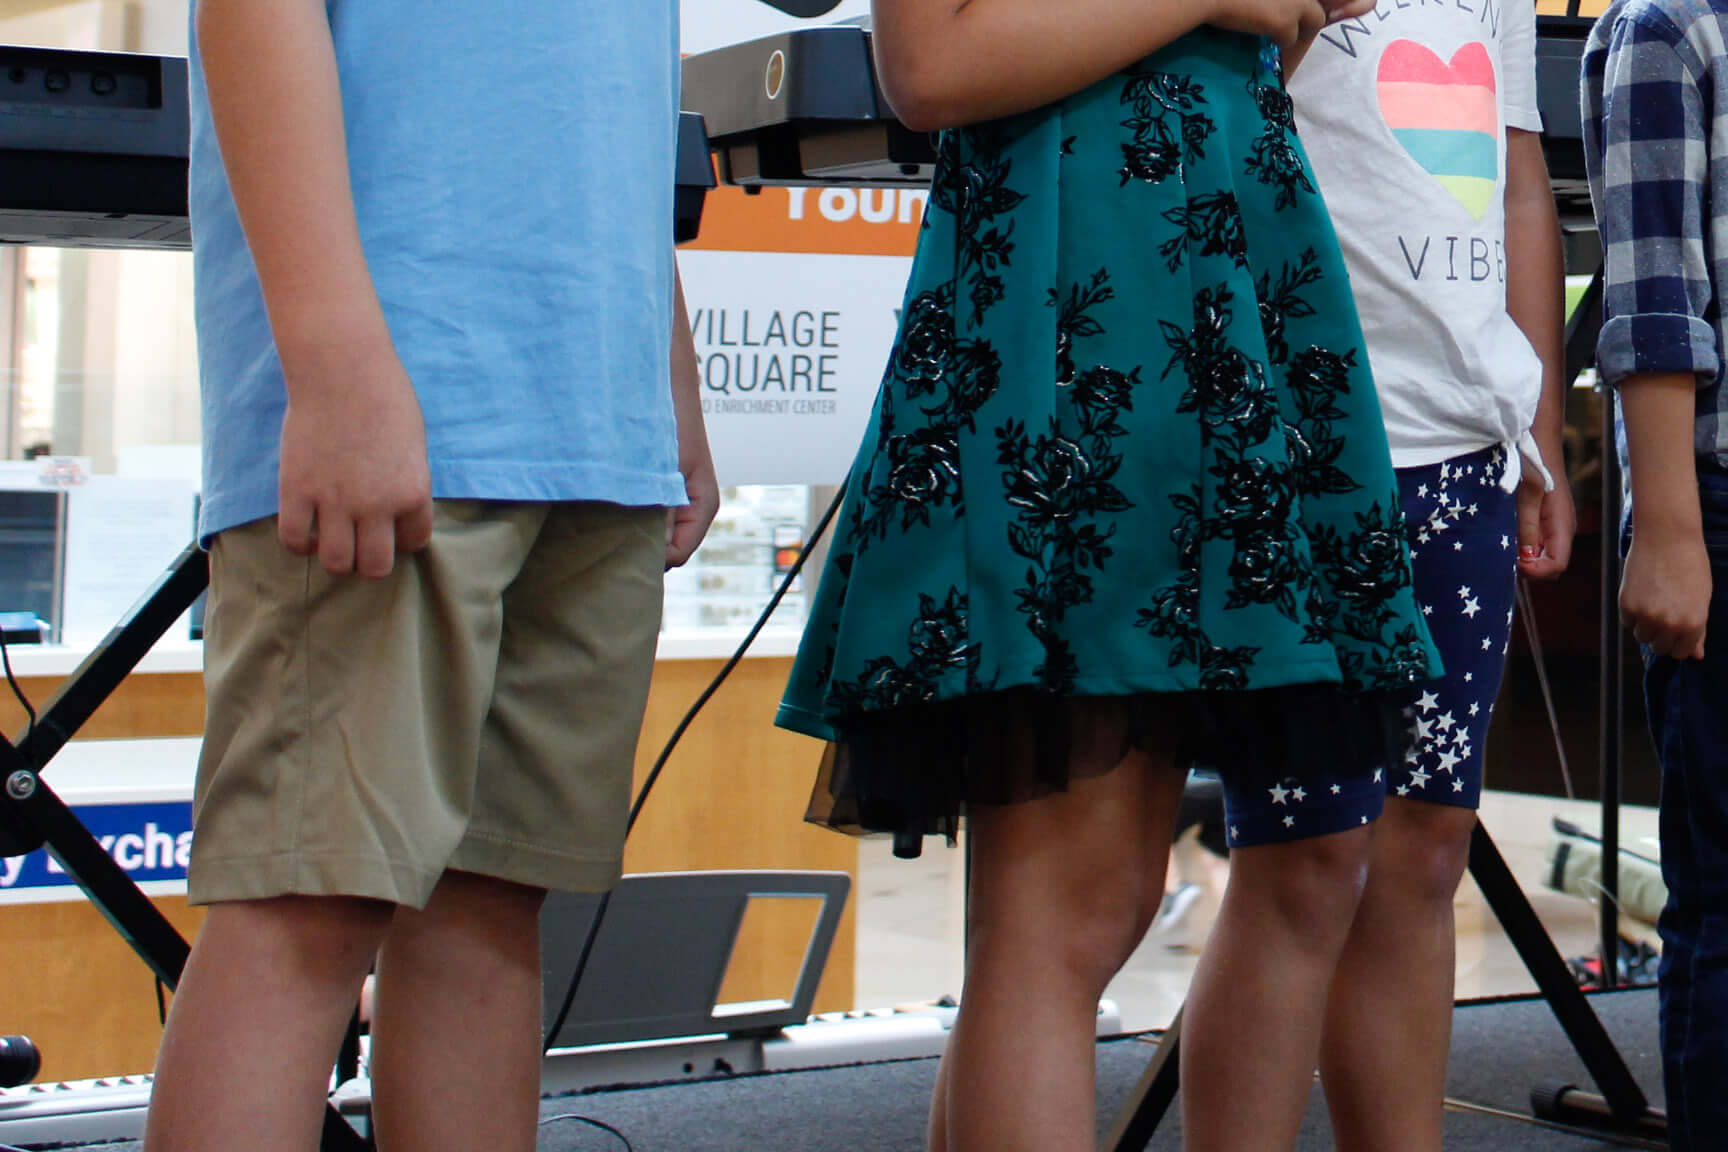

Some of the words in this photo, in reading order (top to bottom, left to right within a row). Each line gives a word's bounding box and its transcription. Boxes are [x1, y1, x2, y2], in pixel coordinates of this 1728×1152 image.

[697, 352, 839, 395] QUARE
[715, 399, 789, 414] ENRICHMENT
[793, 400, 837, 415] CENTER
